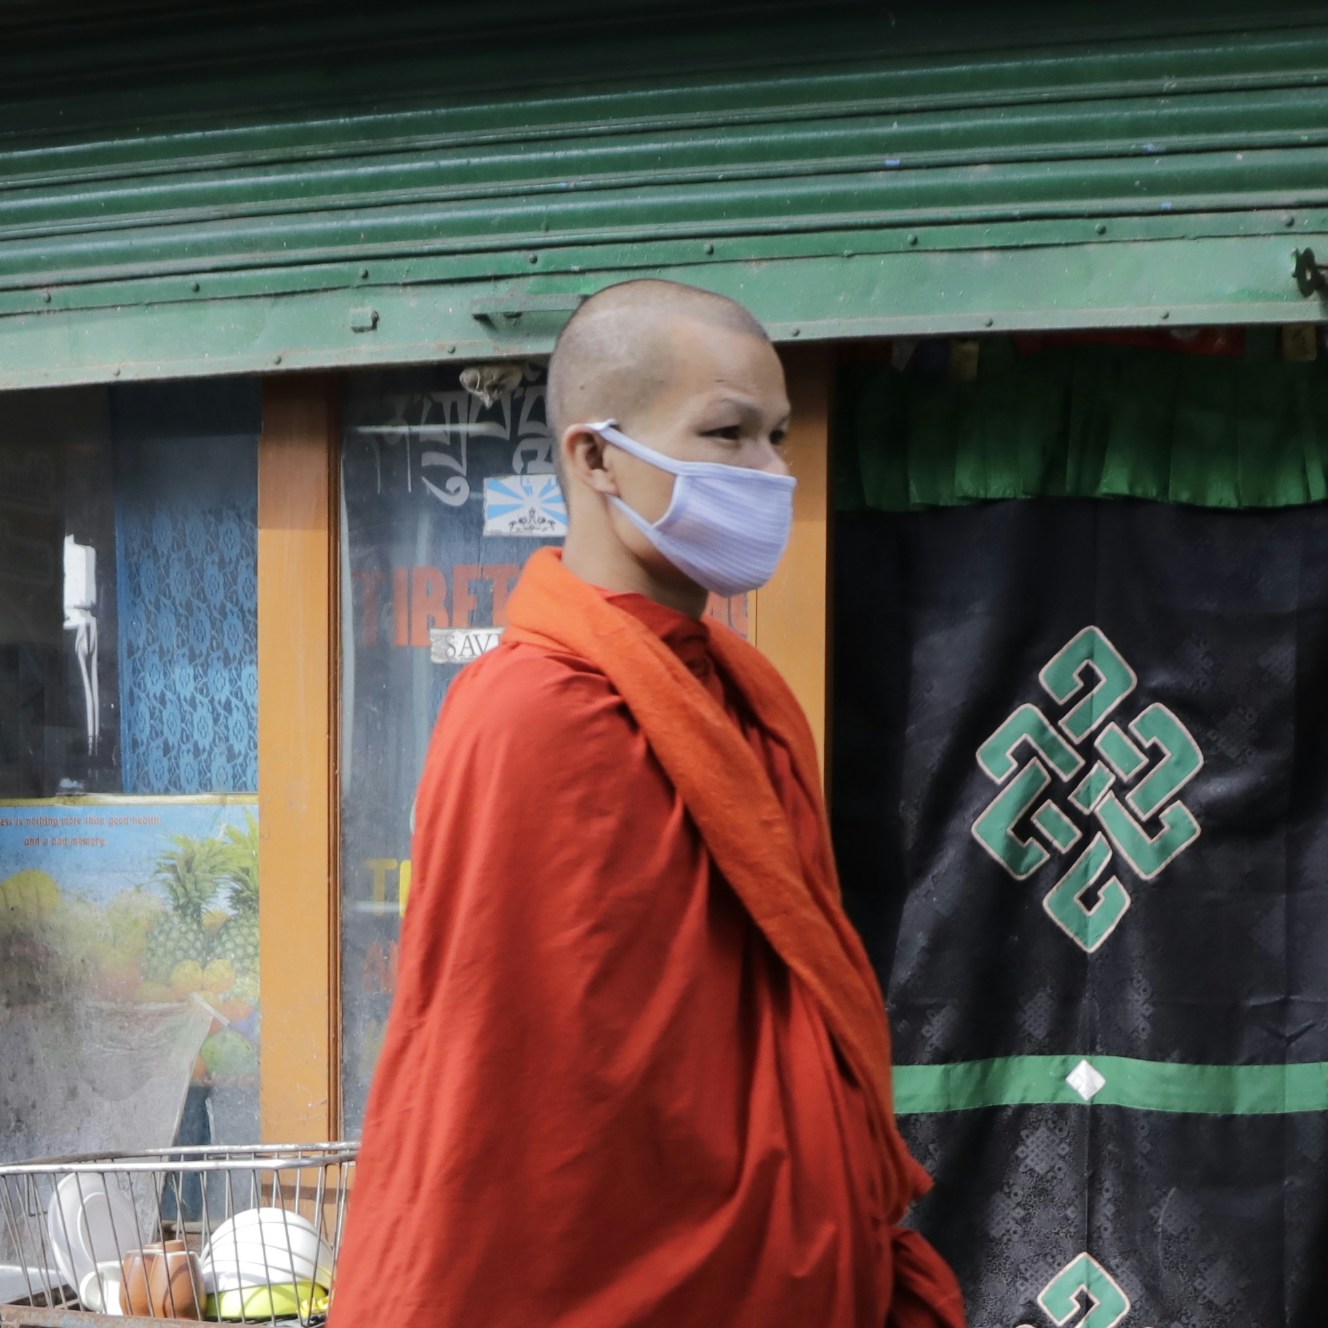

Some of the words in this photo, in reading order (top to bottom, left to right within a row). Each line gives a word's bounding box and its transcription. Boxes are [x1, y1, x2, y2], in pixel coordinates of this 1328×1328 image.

[444, 632, 499, 658] SAV
[16, 816, 23, 826] is
[26, 815, 58, 827] nothing
[61, 816, 81, 825] more
[108, 815, 129, 827] good
[24, 836, 39, 846] and
